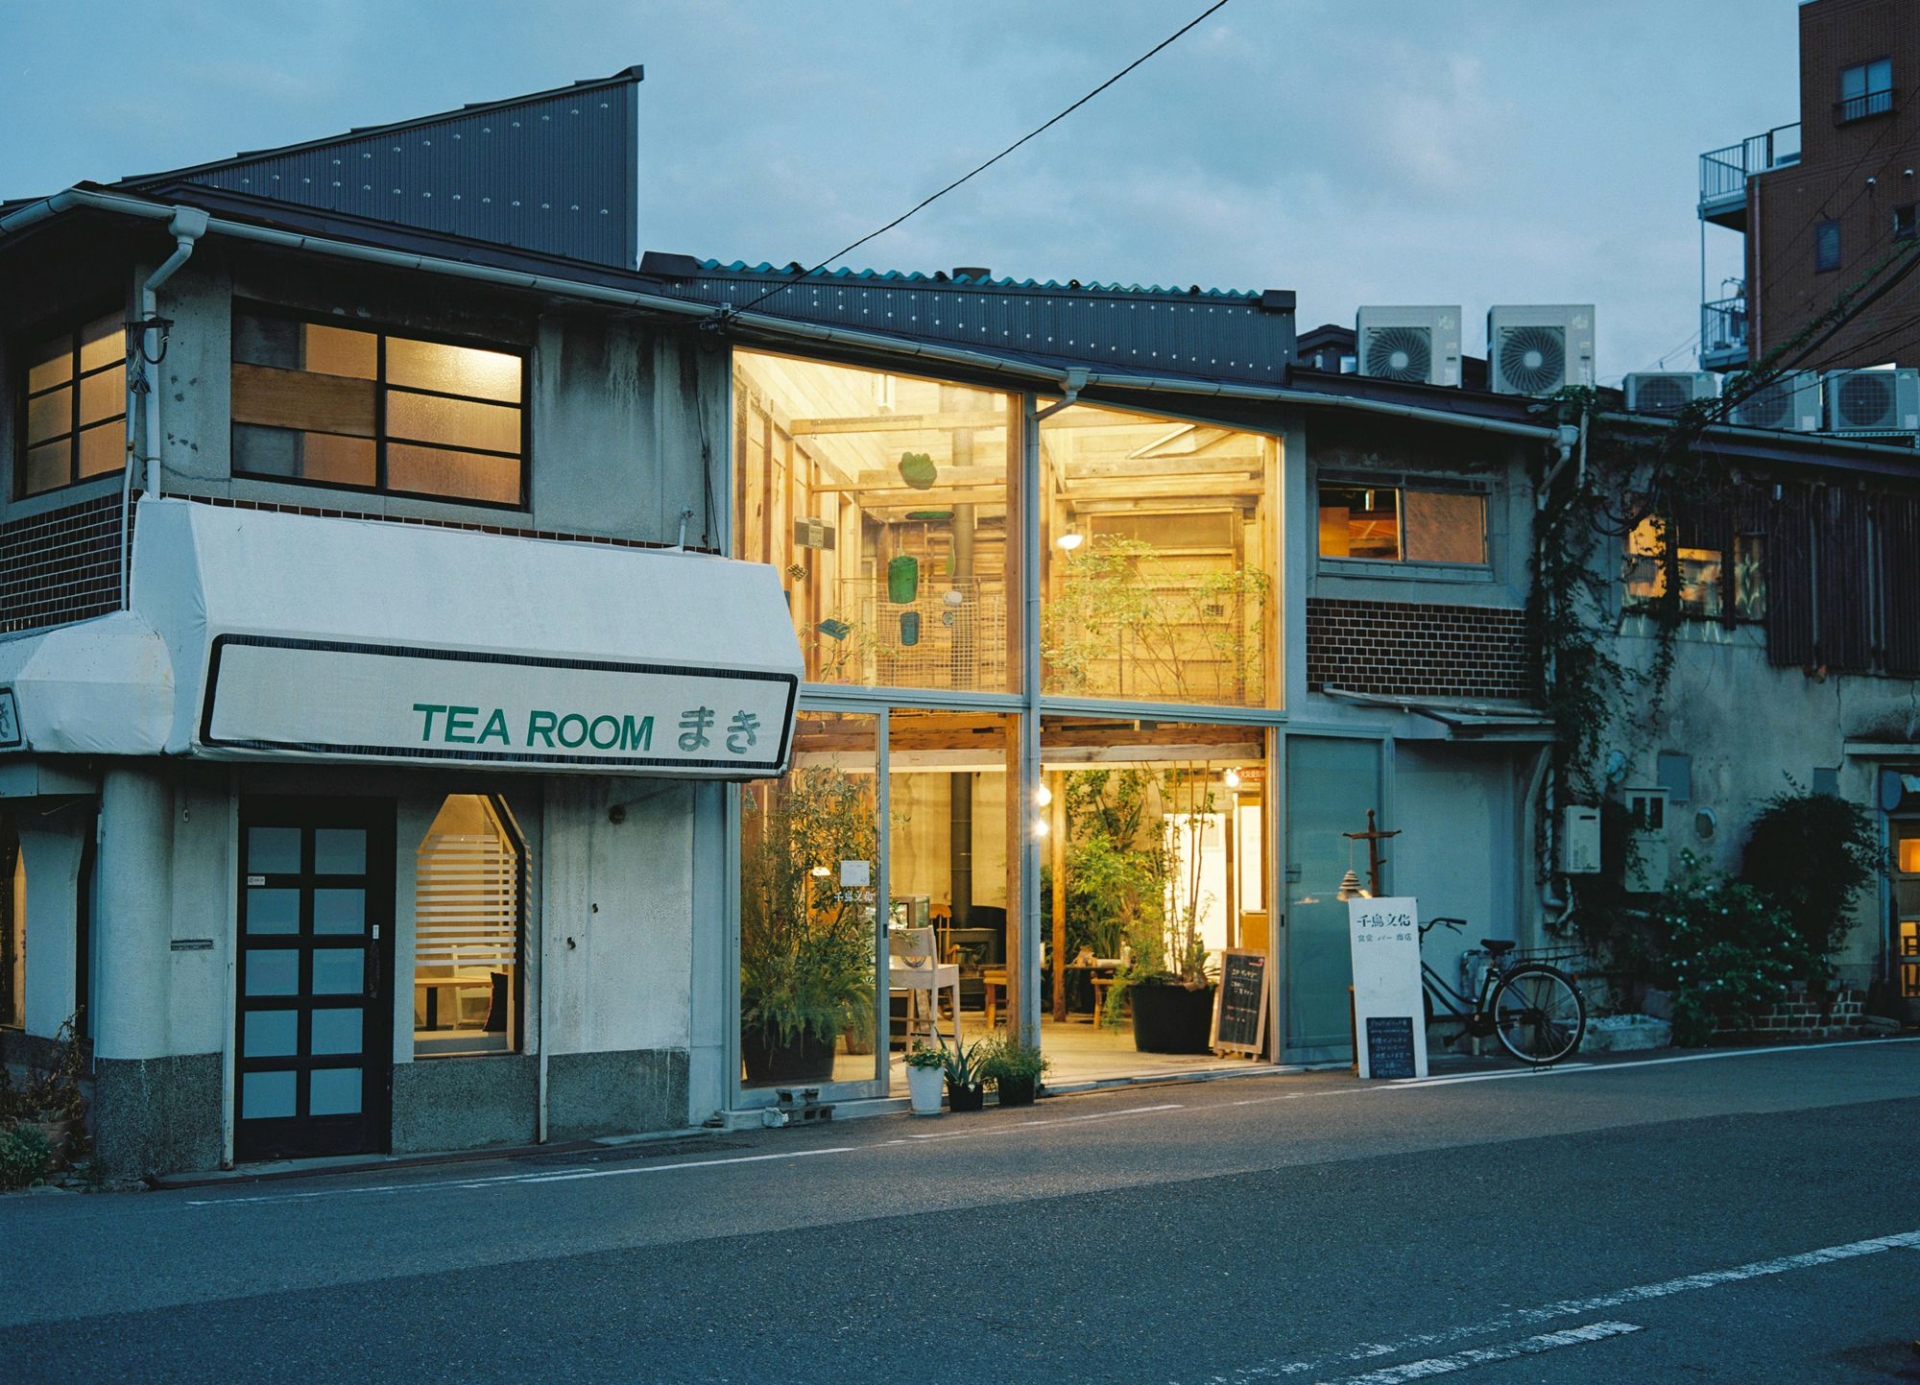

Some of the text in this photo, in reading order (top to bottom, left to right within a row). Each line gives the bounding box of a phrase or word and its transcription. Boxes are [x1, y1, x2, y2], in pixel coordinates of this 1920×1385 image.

[413, 703, 761, 754] TEA ROOM まき
